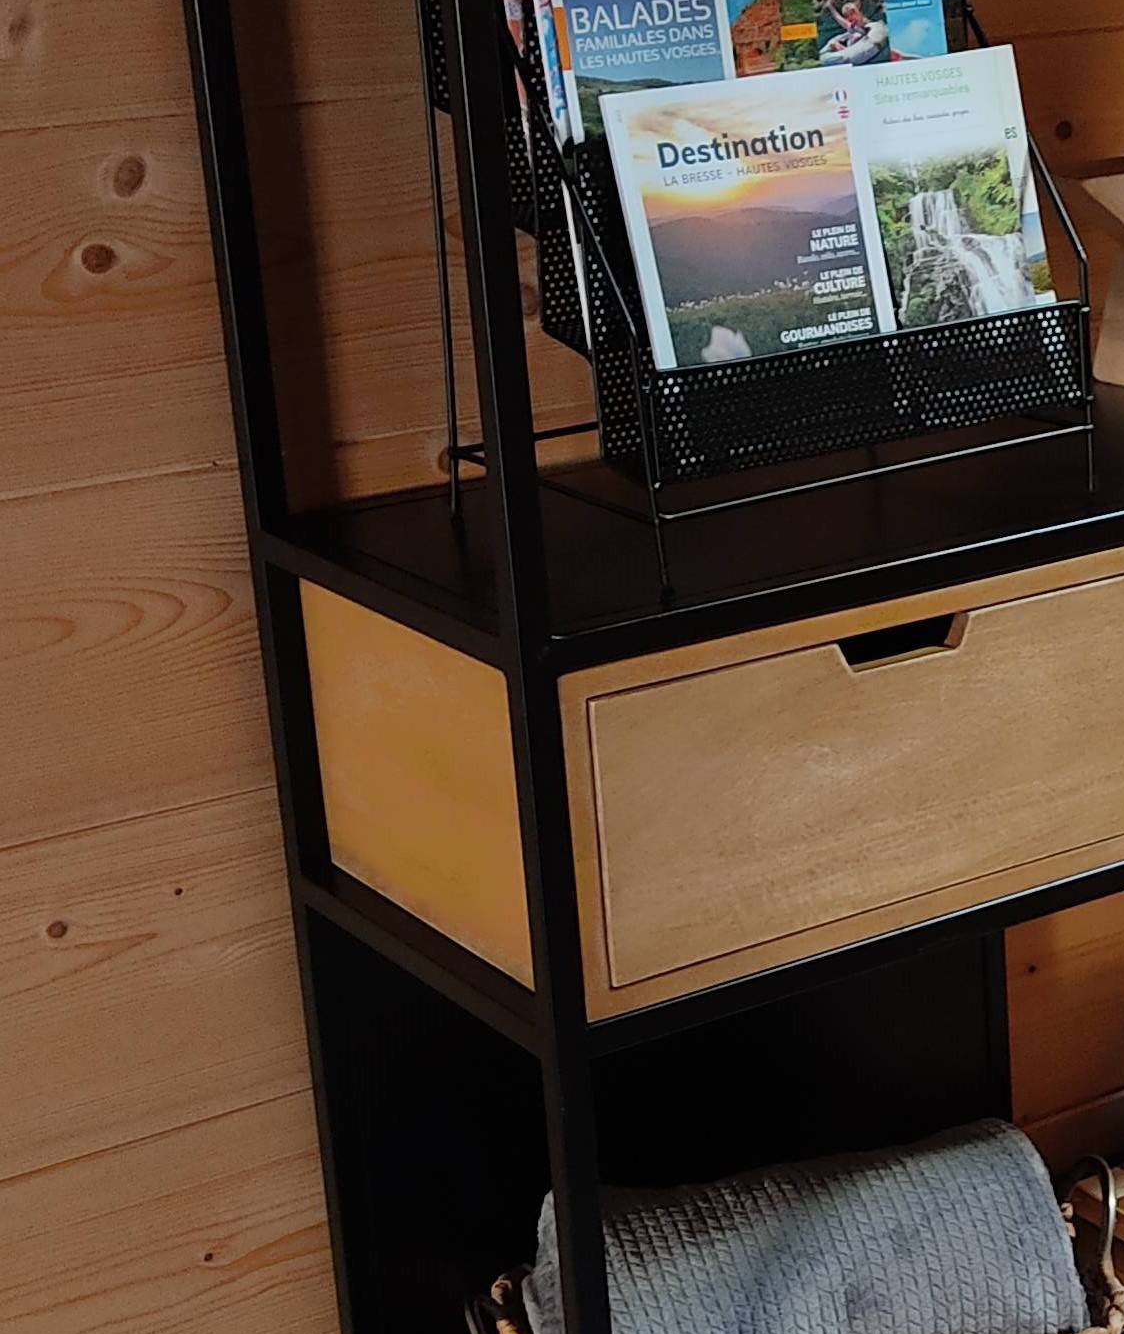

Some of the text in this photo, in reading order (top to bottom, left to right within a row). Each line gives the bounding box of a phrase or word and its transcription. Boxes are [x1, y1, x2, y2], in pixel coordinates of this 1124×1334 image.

[575, 23, 714, 53] FAMILIALES DANS
[579, 51, 605, 69] LES
[606, 47, 662, 66] HAUTES
[876, 67, 964, 87] HAUTES VOSGES
[874, 83, 970, 105] Sites remarquables
[657, 125, 824, 168] Destination
[664, 173, 678, 187] LA
[682, 169, 723, 185] BRESSE
[736, 161, 781, 177] HAUTES
[784, 154, 827, 170] VOSGES
[811, 224, 857, 238] LE PLEIN DE
[809, 233, 859, 252] NATURE
[820, 265, 864, 280] LE PLEIN DE
[813, 275, 866, 295] CULTURE
[827, 307, 871, 322] LE PLEIN DE
[780, 317, 873, 344] GOURMANDISES
